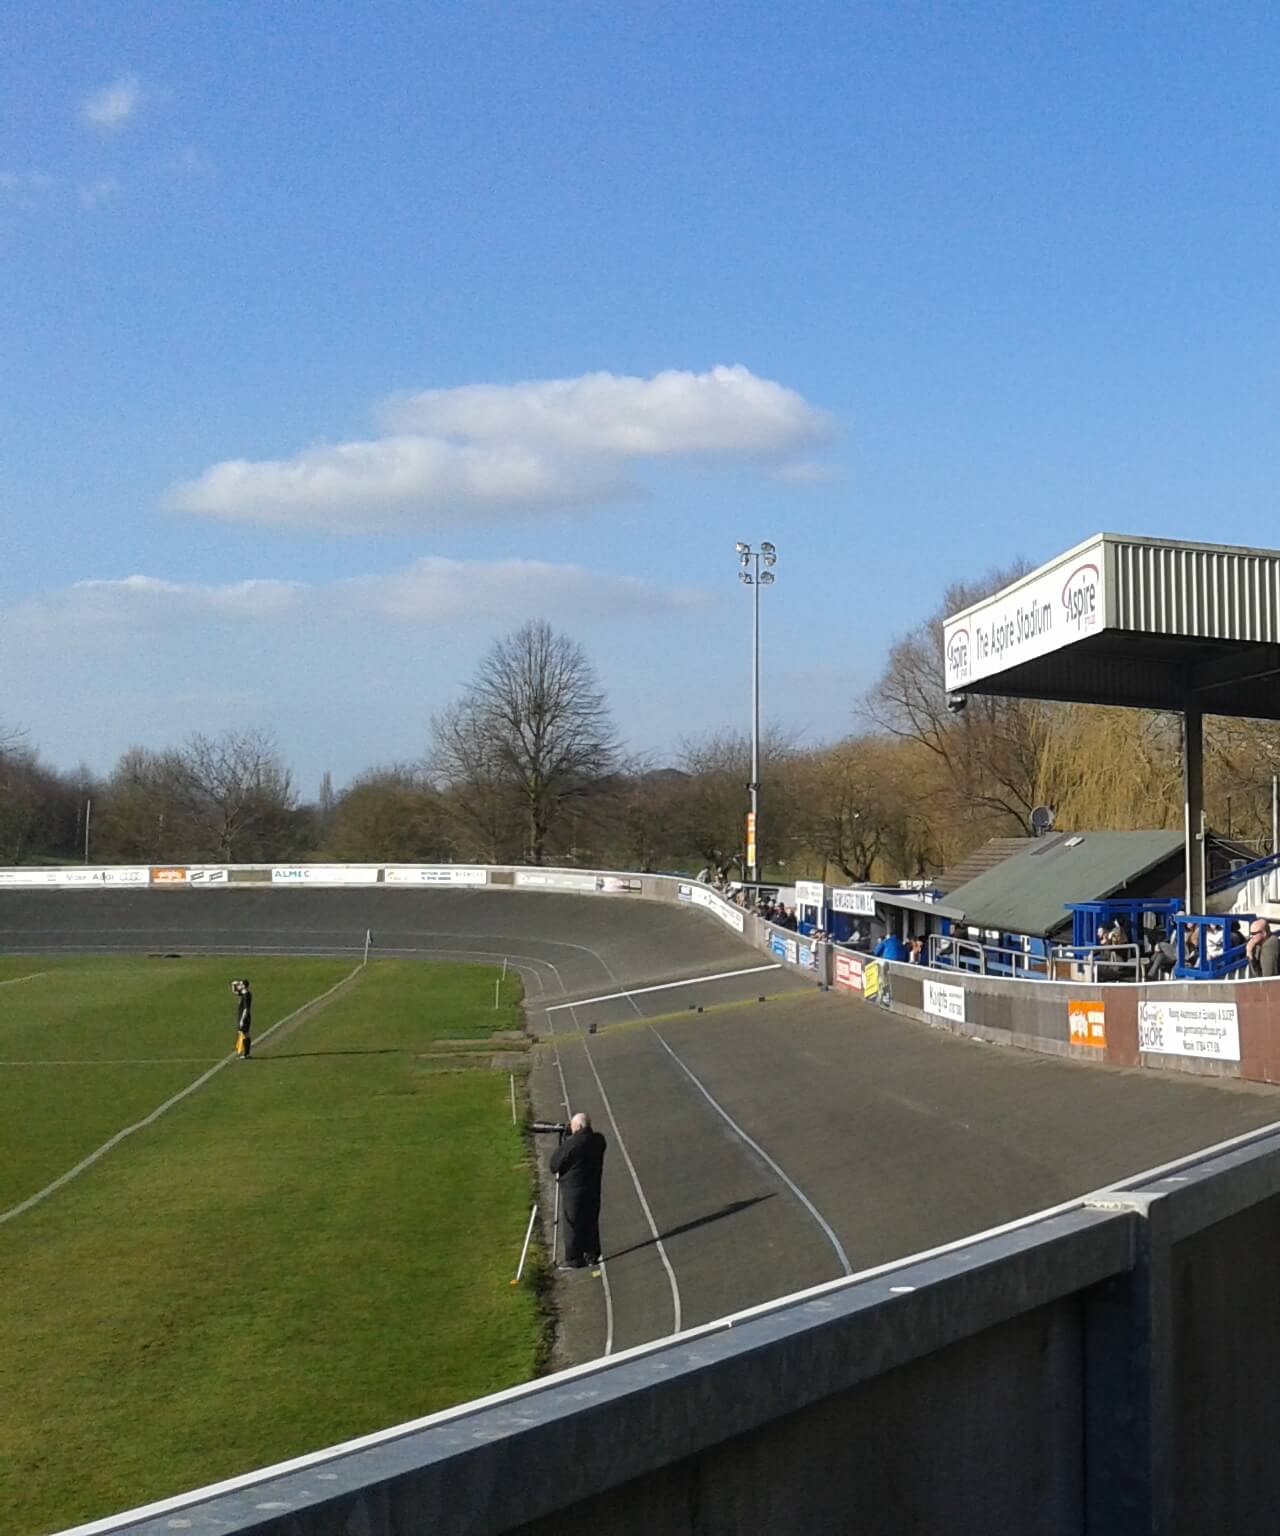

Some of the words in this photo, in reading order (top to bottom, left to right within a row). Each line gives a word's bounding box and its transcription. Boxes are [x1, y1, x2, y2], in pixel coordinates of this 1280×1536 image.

[1066, 574, 1096, 631] Aspire
[976, 628, 989, 661] The
[990, 615, 1015, 662] Aspire
[1016, 599, 1052, 645] Stadium
[950, 637, 968, 680] Aspire
[274, 870, 311, 878] ALMEC
